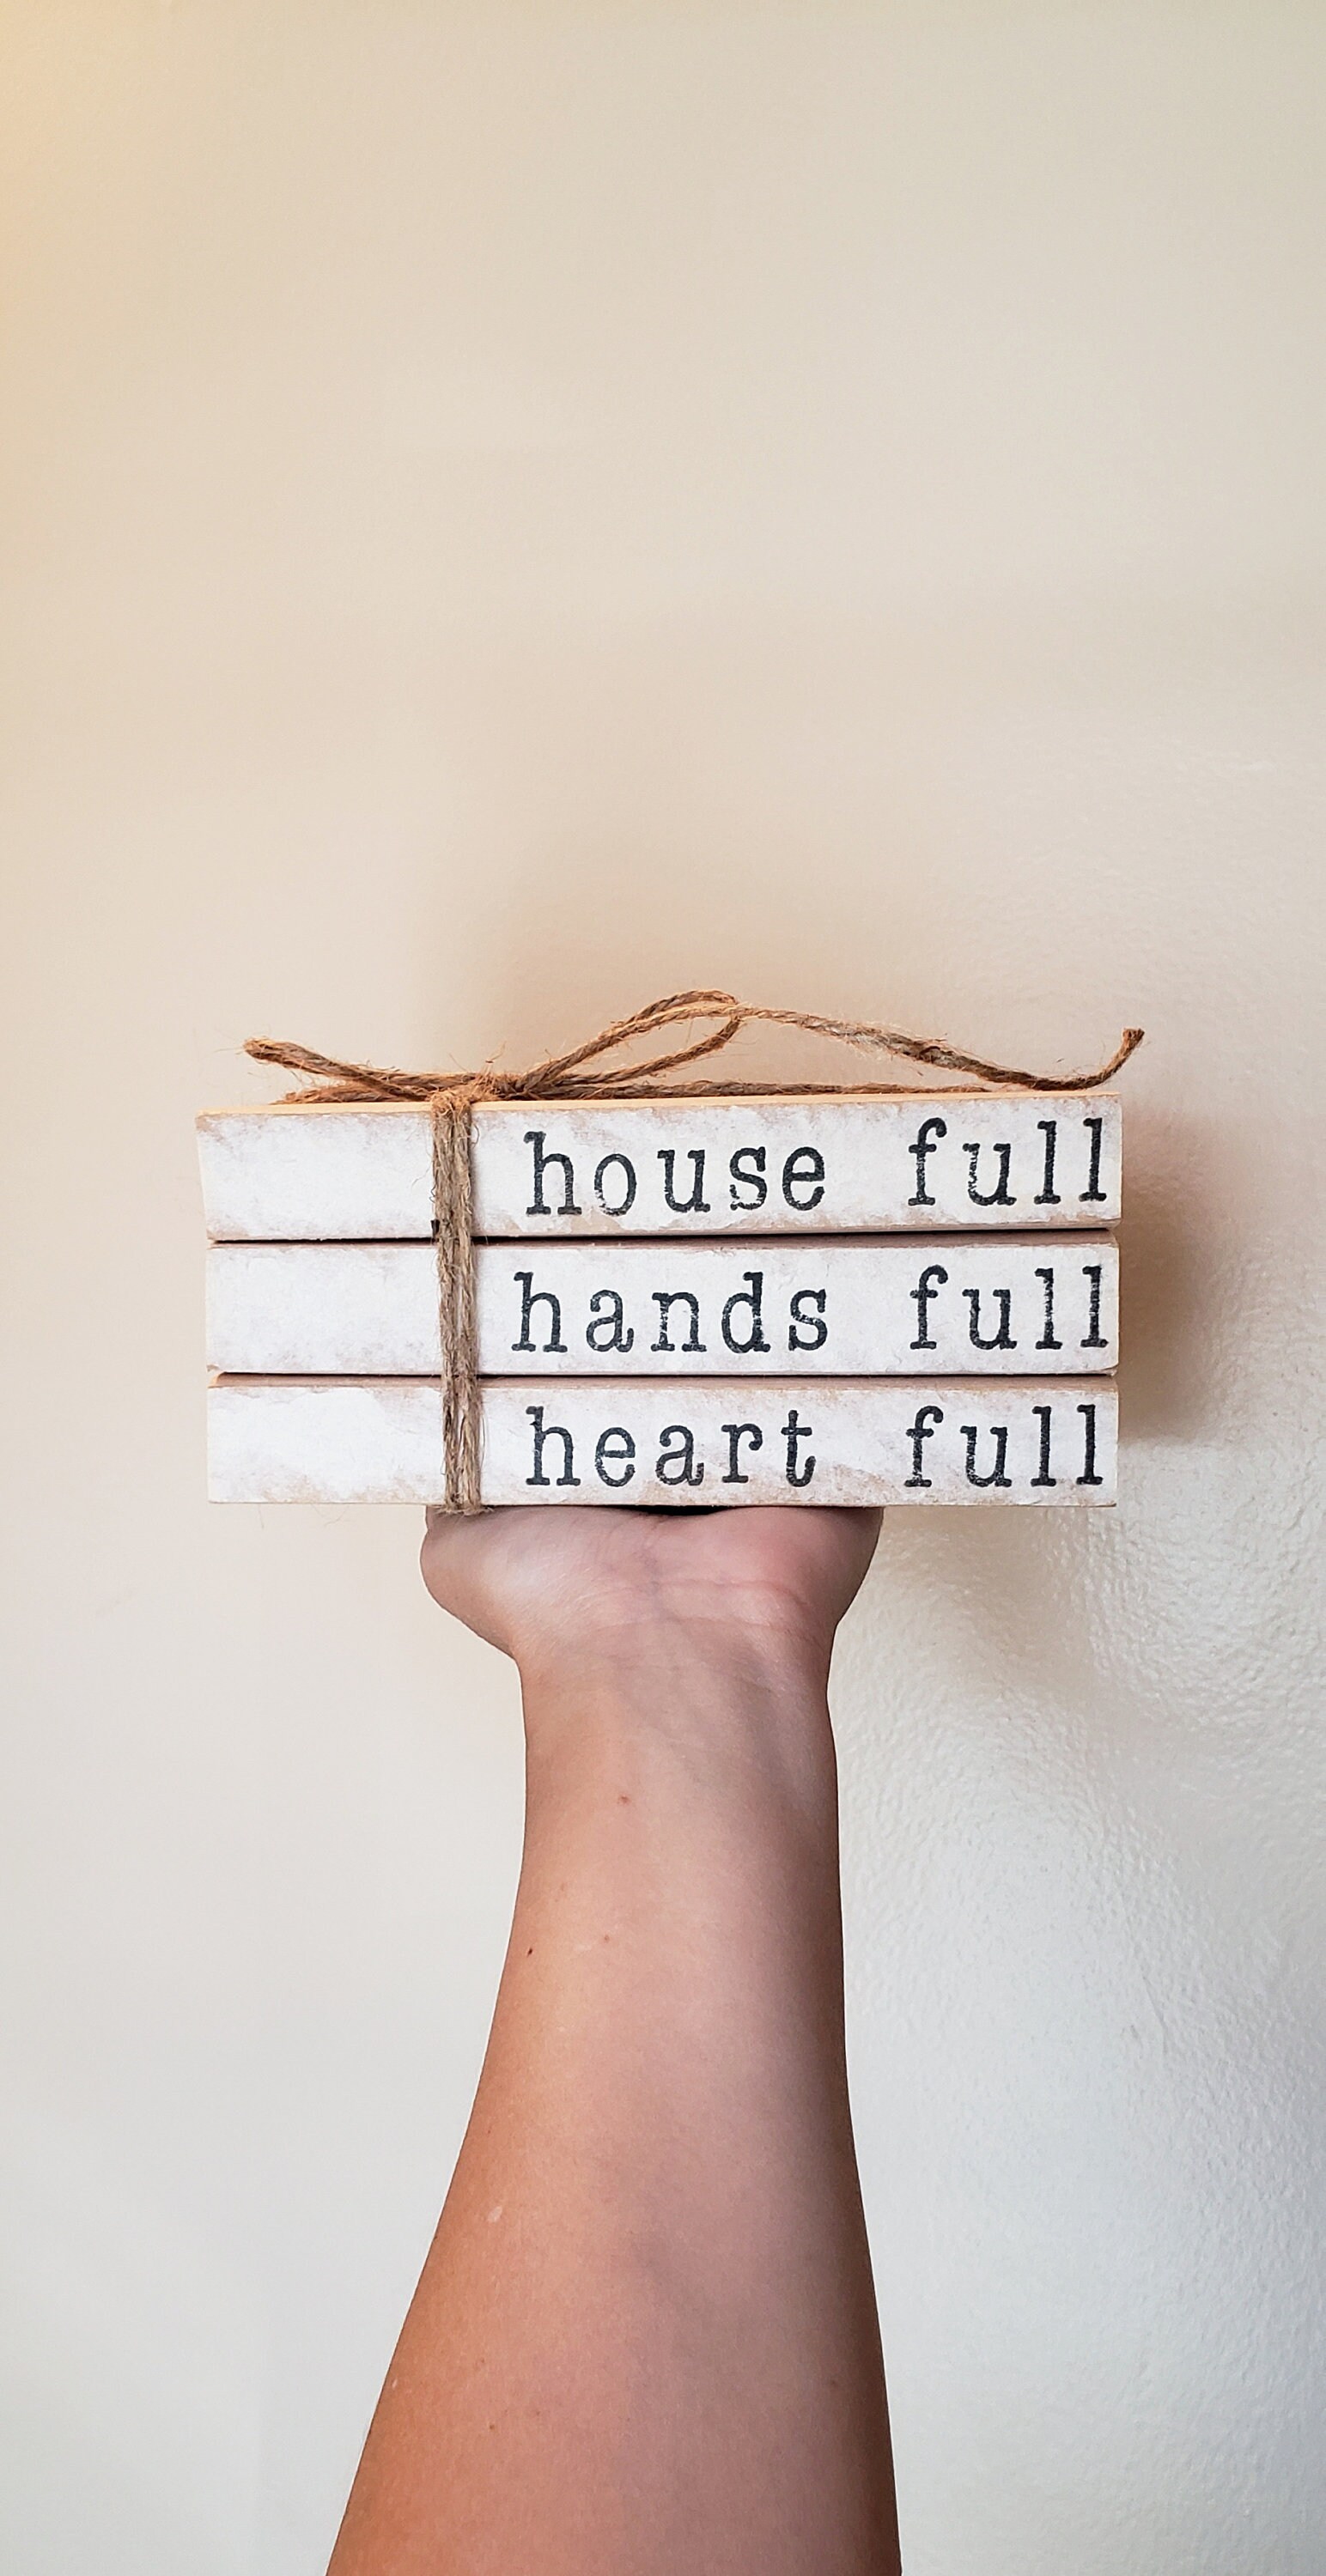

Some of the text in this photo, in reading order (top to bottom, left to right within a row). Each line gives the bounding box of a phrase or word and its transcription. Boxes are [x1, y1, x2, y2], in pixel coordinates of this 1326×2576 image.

[524, 1117, 1108, 1216] house full
[512, 1265, 1109, 1353] hands full
[526, 1404, 1104, 1487] heart full
